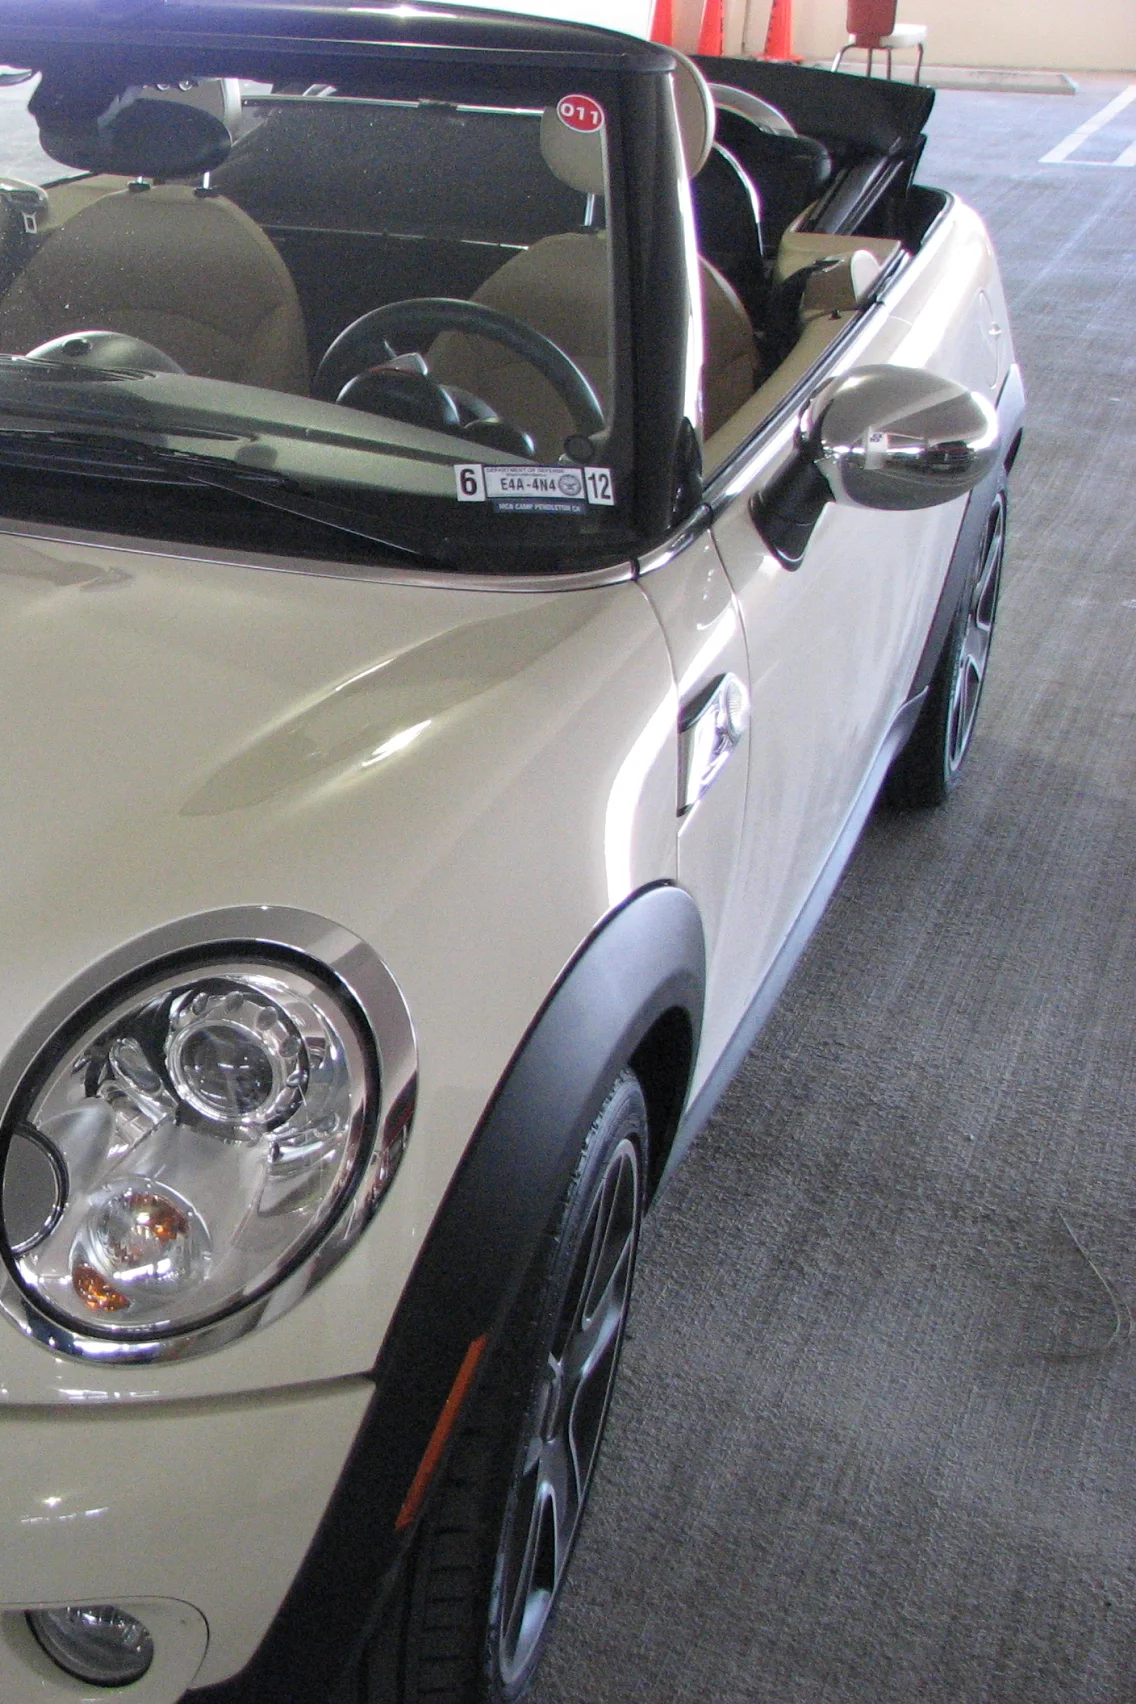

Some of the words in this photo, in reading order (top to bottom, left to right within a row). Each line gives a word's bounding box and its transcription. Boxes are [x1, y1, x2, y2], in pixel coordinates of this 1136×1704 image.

[560, 103, 599, 125] 011
[460, 468, 478, 496] 6
[588, 472, 612, 500] 12
